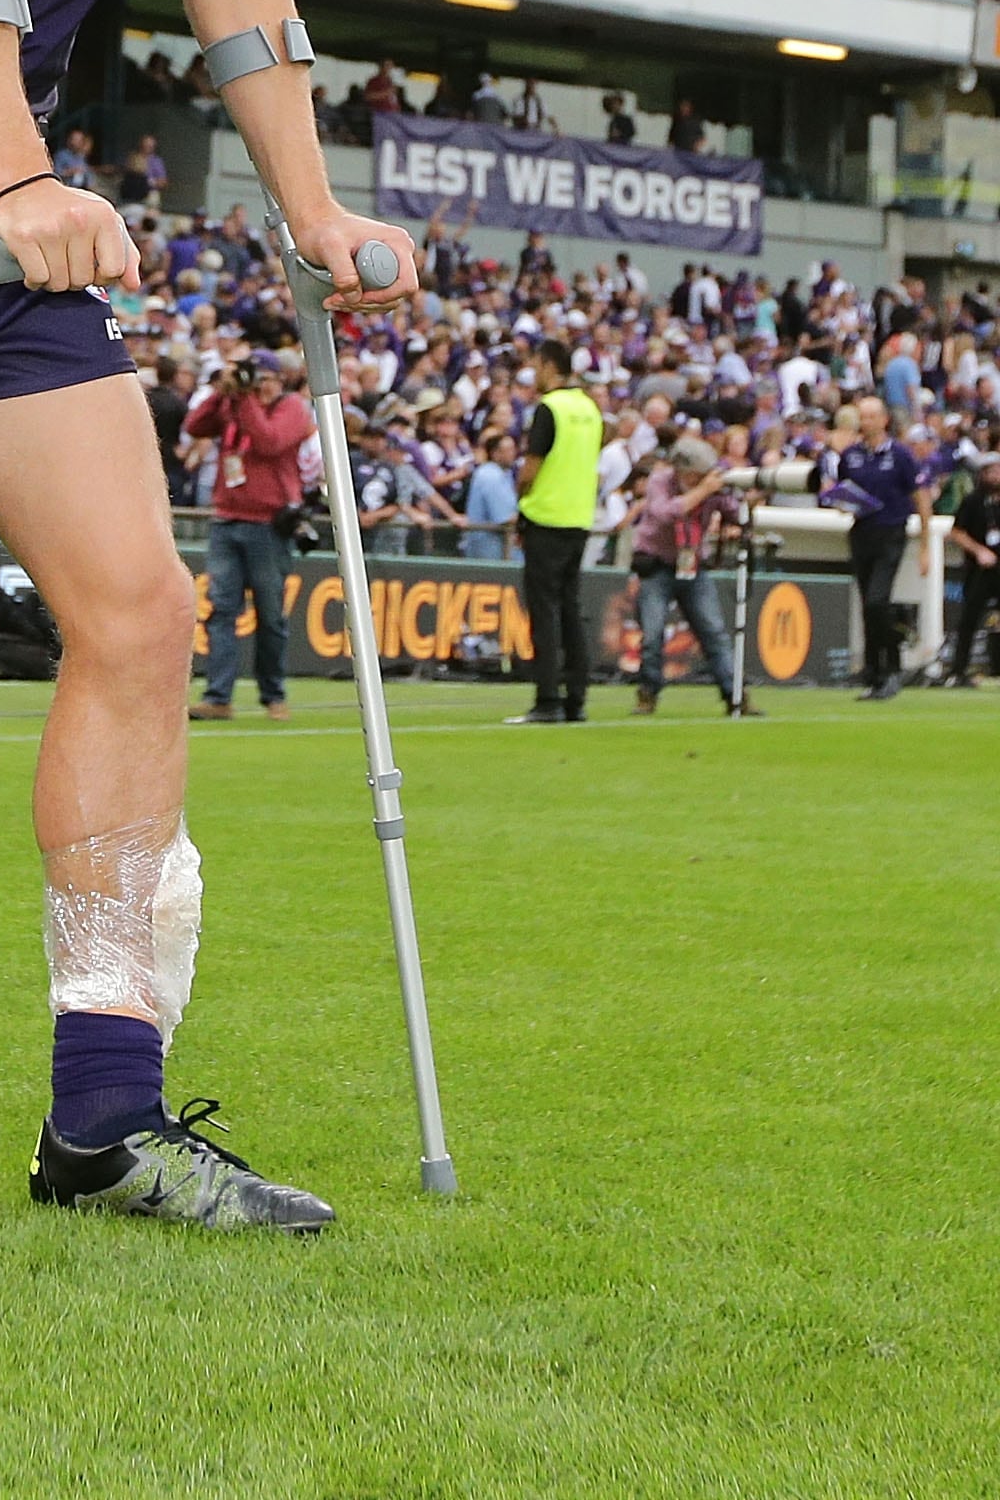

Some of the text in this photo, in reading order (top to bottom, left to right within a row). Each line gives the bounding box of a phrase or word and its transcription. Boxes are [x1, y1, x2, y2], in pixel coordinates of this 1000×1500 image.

[379, 138, 761, 231] LEST WE FORGET
